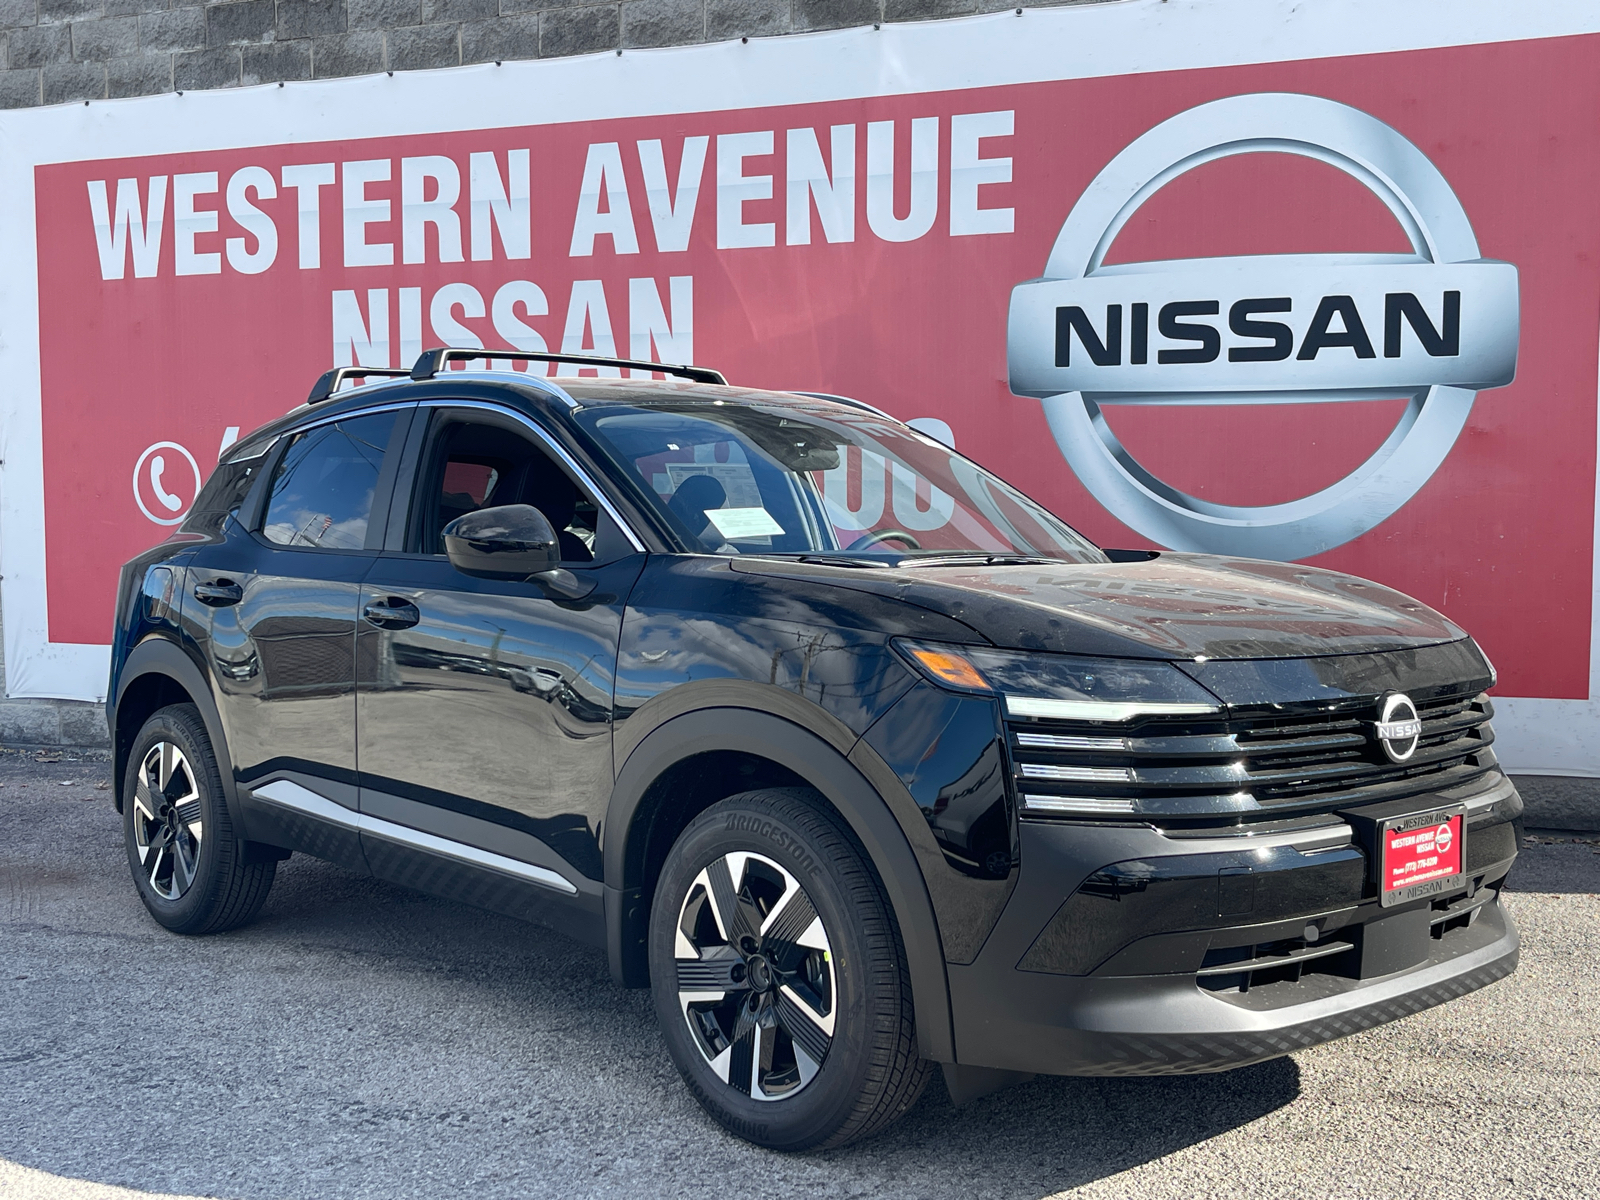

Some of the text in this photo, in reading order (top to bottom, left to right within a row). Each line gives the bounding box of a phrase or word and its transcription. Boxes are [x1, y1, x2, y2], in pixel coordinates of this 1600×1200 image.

[87, 109, 1016, 282] WESTERN AVENUE
[331, 275, 695, 389] NISSAN
[1054, 289, 1462, 368] NISSAN
[172, 720, 201, 764] TURANZA
[1379, 722, 1422, 739] NISSAN
[1403, 815, 1434, 829] WESTERN
[725, 812, 822, 878] BRIDGESTONE
[1391, 831, 1435, 849] WESTERN AVENUE
[1416, 841, 1435, 854] NISSAN
[1407, 880, 1443, 899] NISSAN
